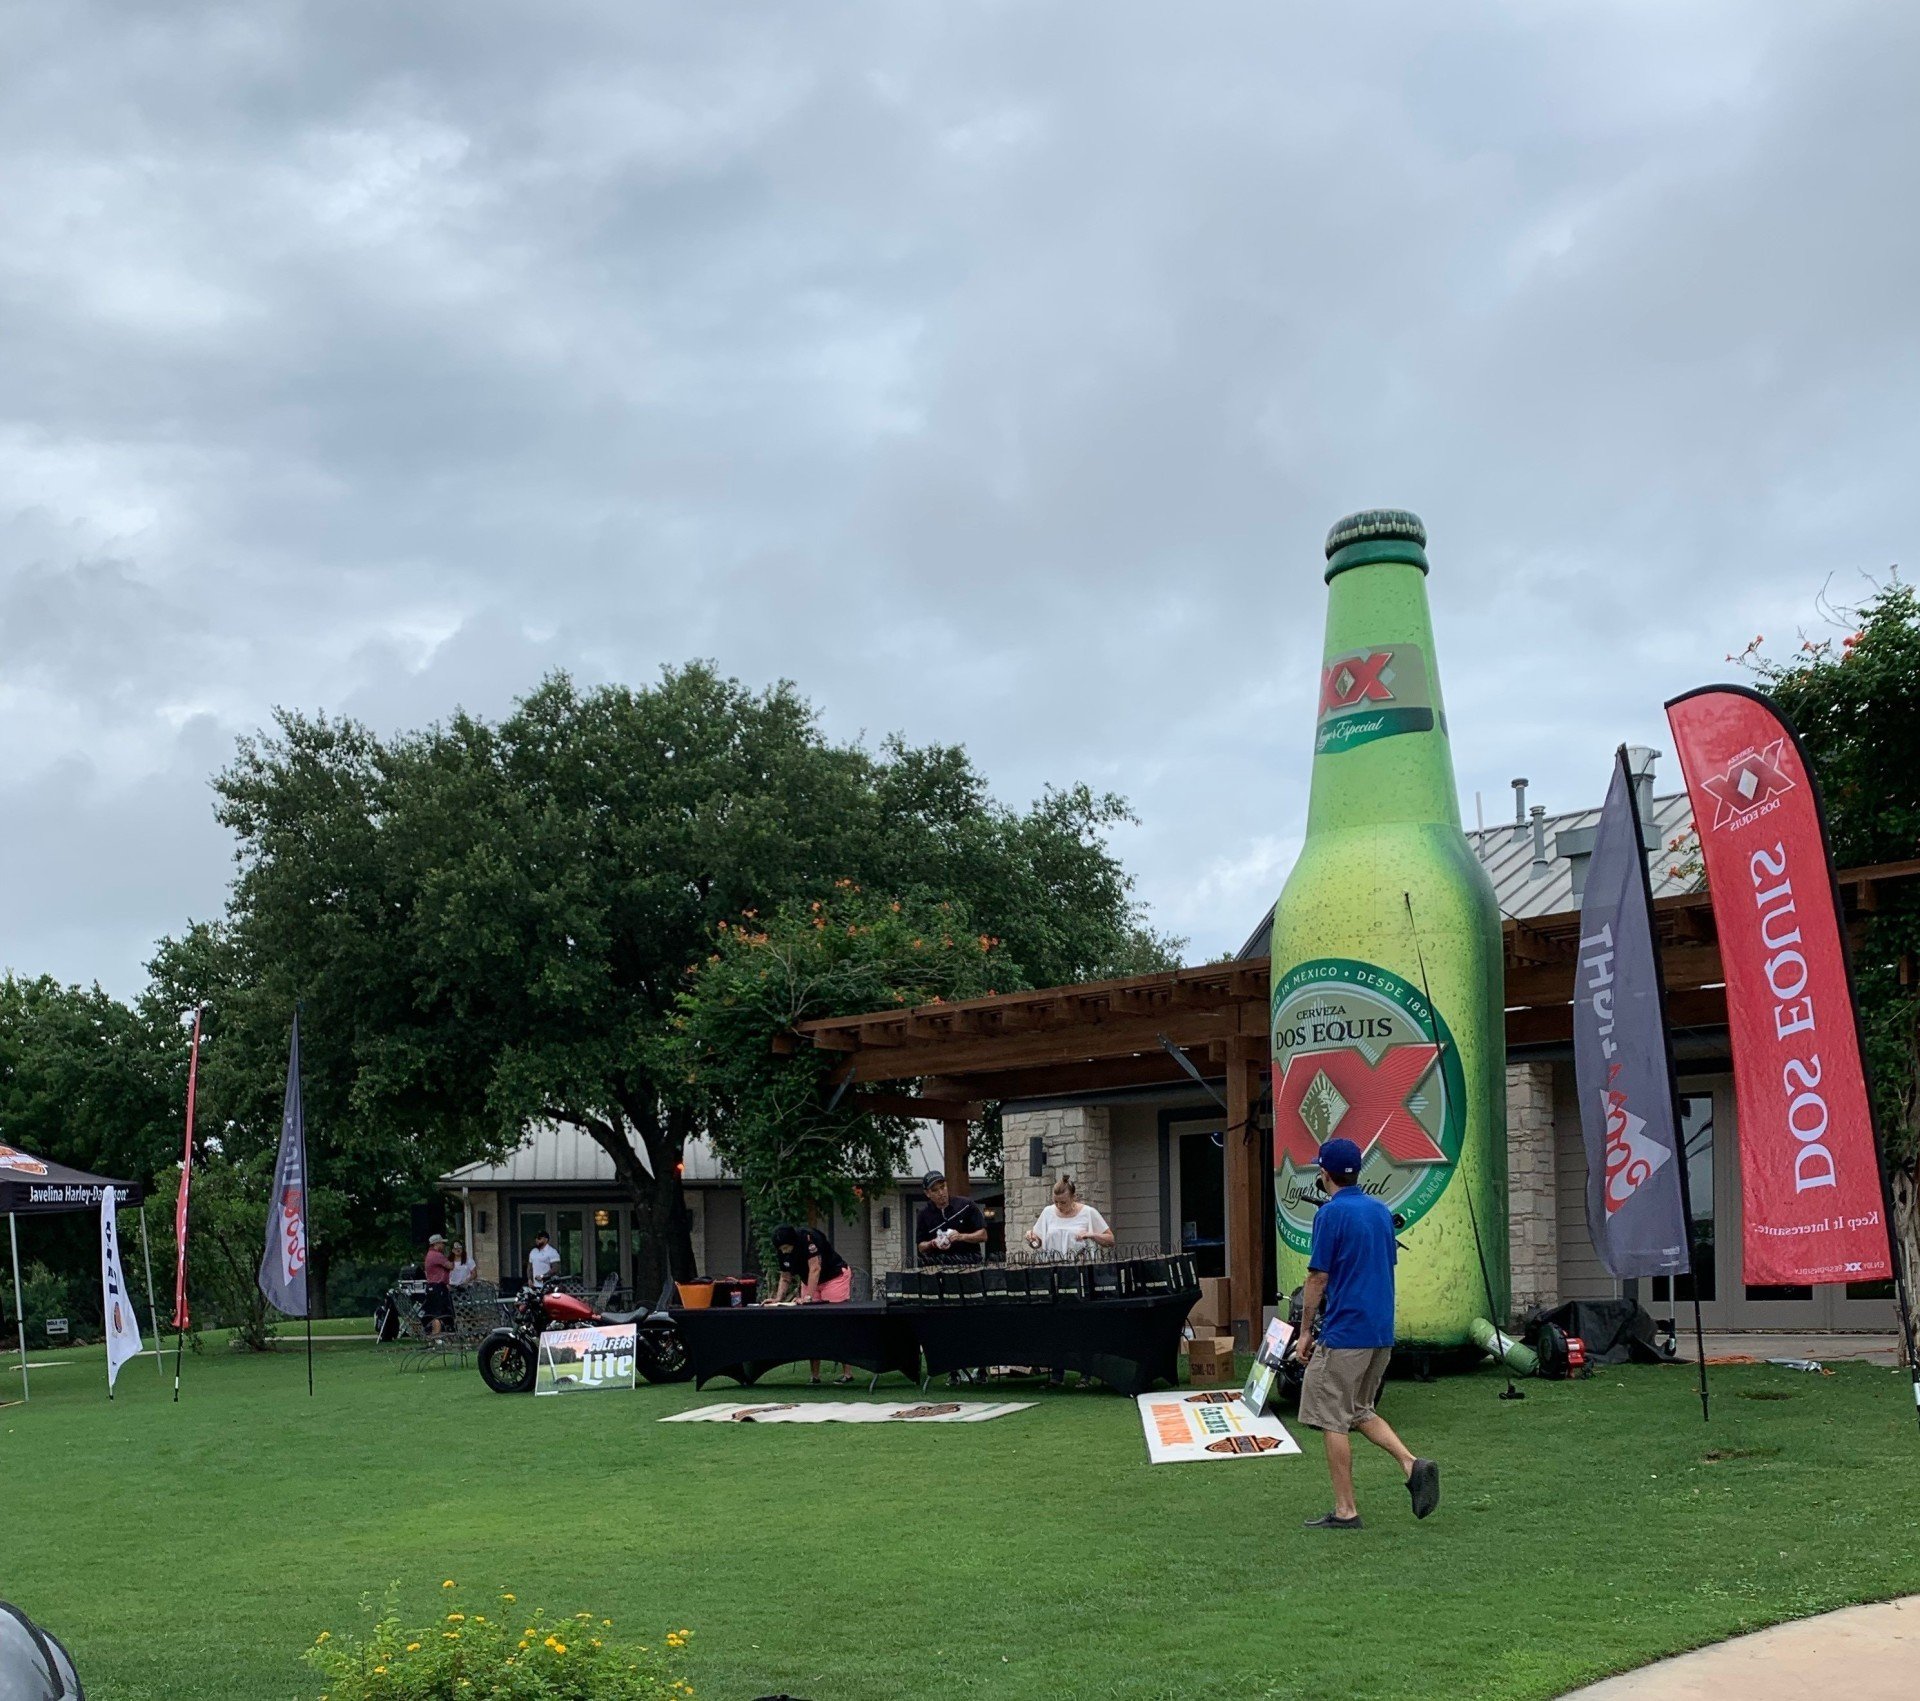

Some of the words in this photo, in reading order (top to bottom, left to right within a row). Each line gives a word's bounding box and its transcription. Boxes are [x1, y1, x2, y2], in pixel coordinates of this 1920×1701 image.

[1336, 716, 1385, 742] Especial
[1293, 967, 1338, 986] MEXICO
[1356, 970, 1404, 998] DESDE
[1296, 1005, 1346, 1020] CERVEZA
[1276, 1026, 1306, 1050] DOS
[1312, 1017, 1393, 1043] EQUIS
[29, 1184, 64, 1203] Javelina
[65, 1184, 127, 1206] Harley-Dason
[1280, 1174, 1318, 1210] Lager
[590, 1337, 634, 1352] GOLFERS
[579, 1352, 633, 1386] Lite
